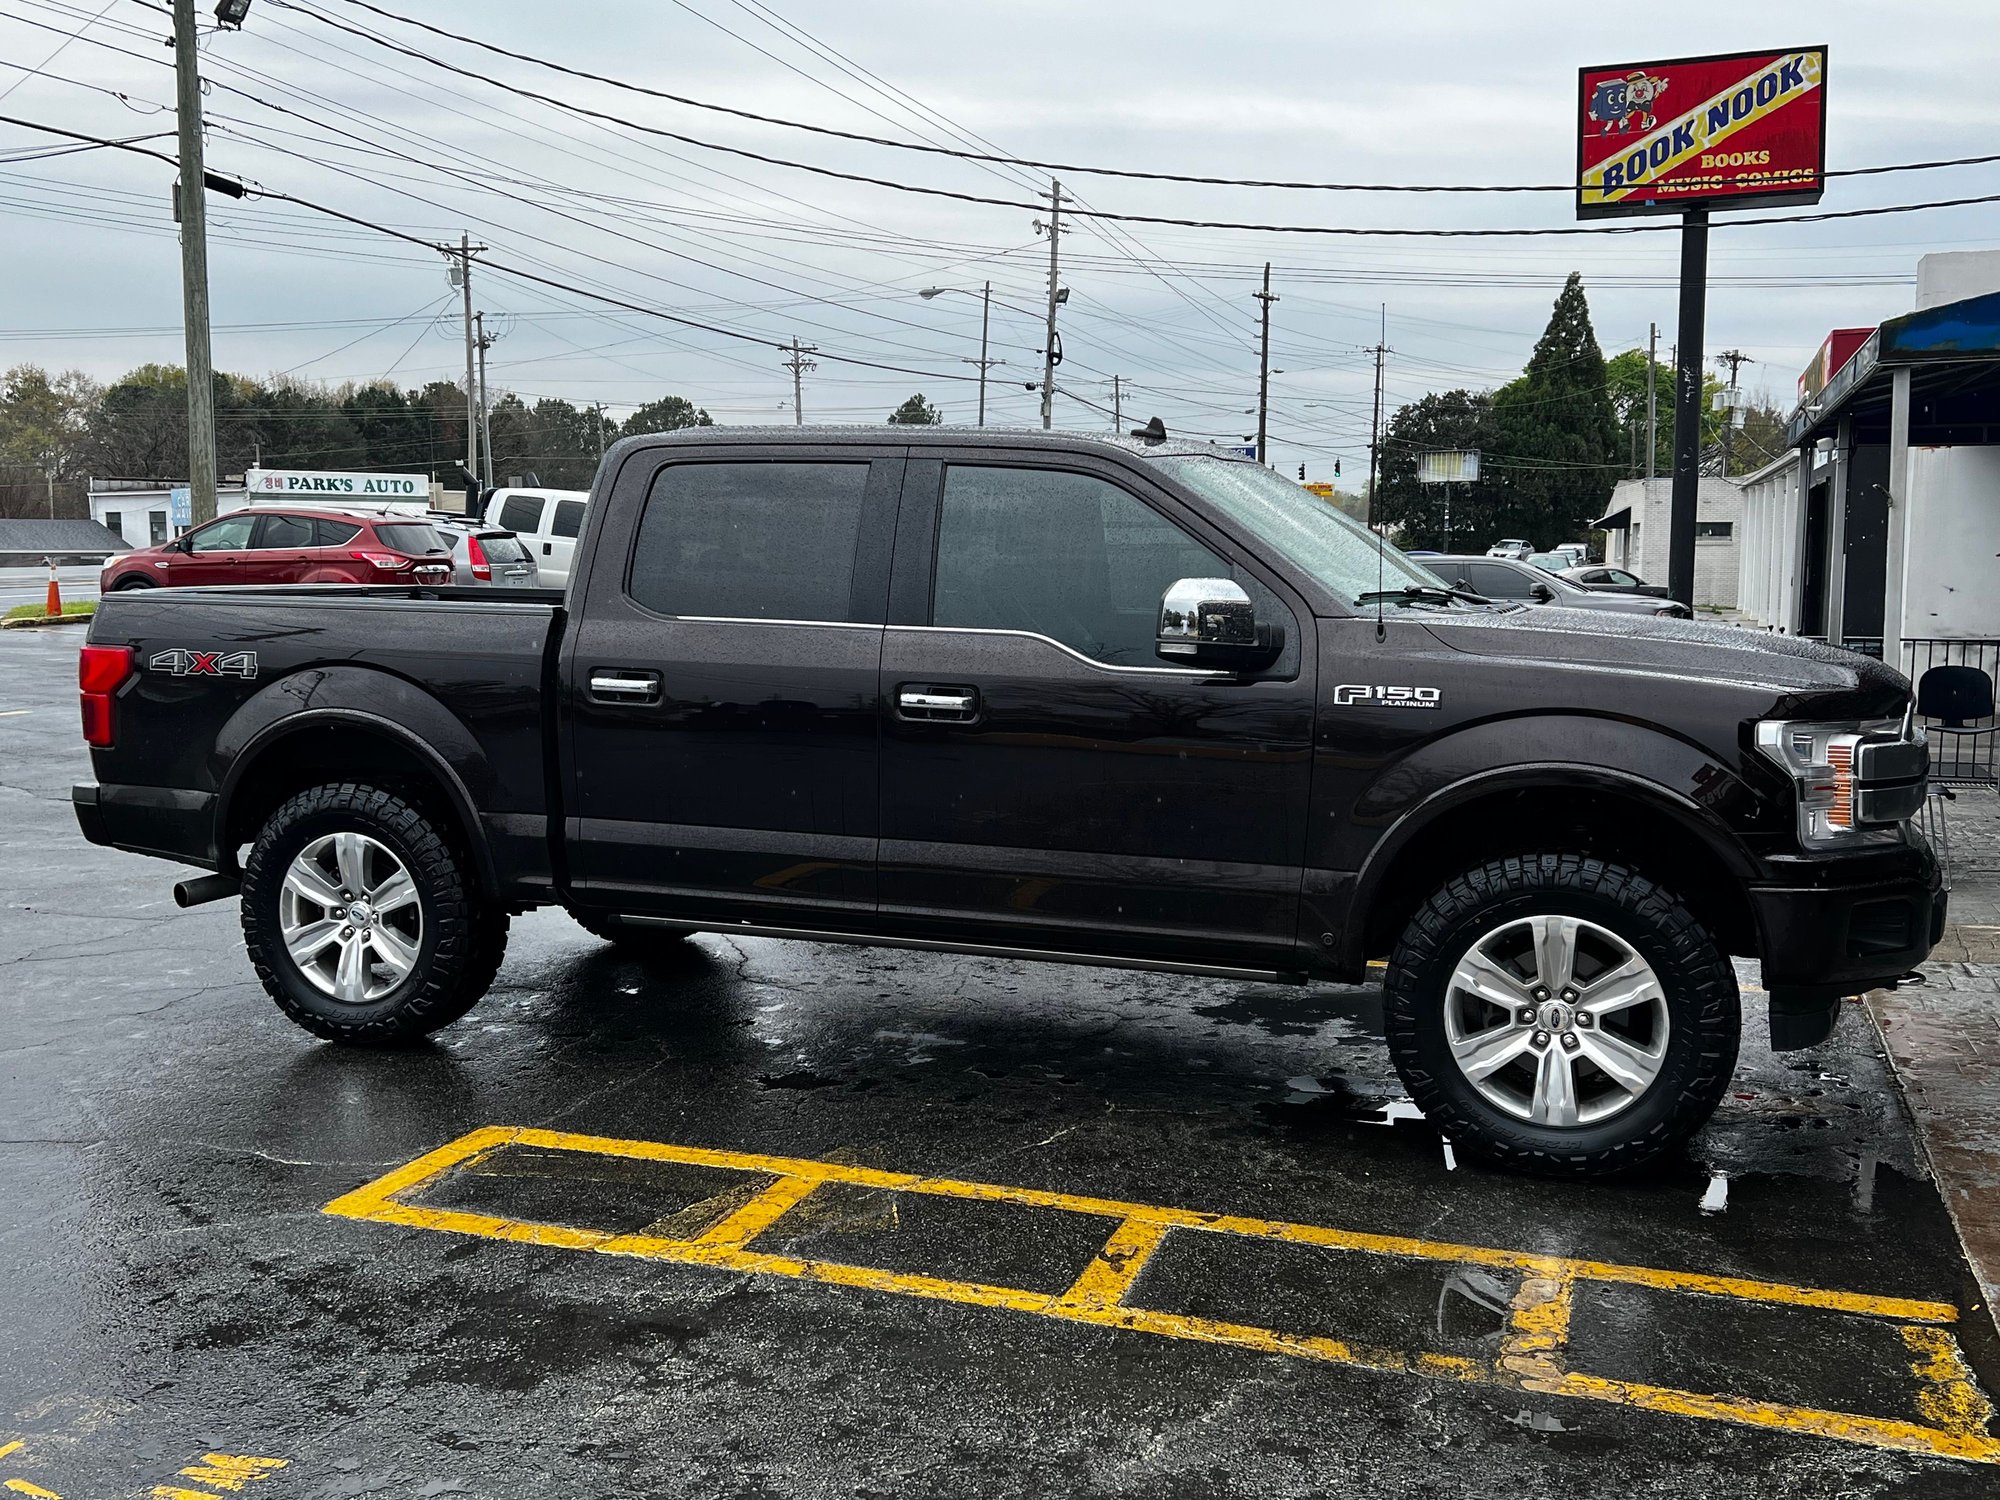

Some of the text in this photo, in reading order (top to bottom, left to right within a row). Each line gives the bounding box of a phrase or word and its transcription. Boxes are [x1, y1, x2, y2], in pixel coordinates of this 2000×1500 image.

[1602, 55, 1804, 198] BOOK NOOK
[1701, 150, 1770, 169] BOOKS
[1657, 168, 1814, 193] MUSIC COMICS
[288, 477, 414, 493] PARK'S AUTO
[1381, 699, 1435, 708] PLATINUM
